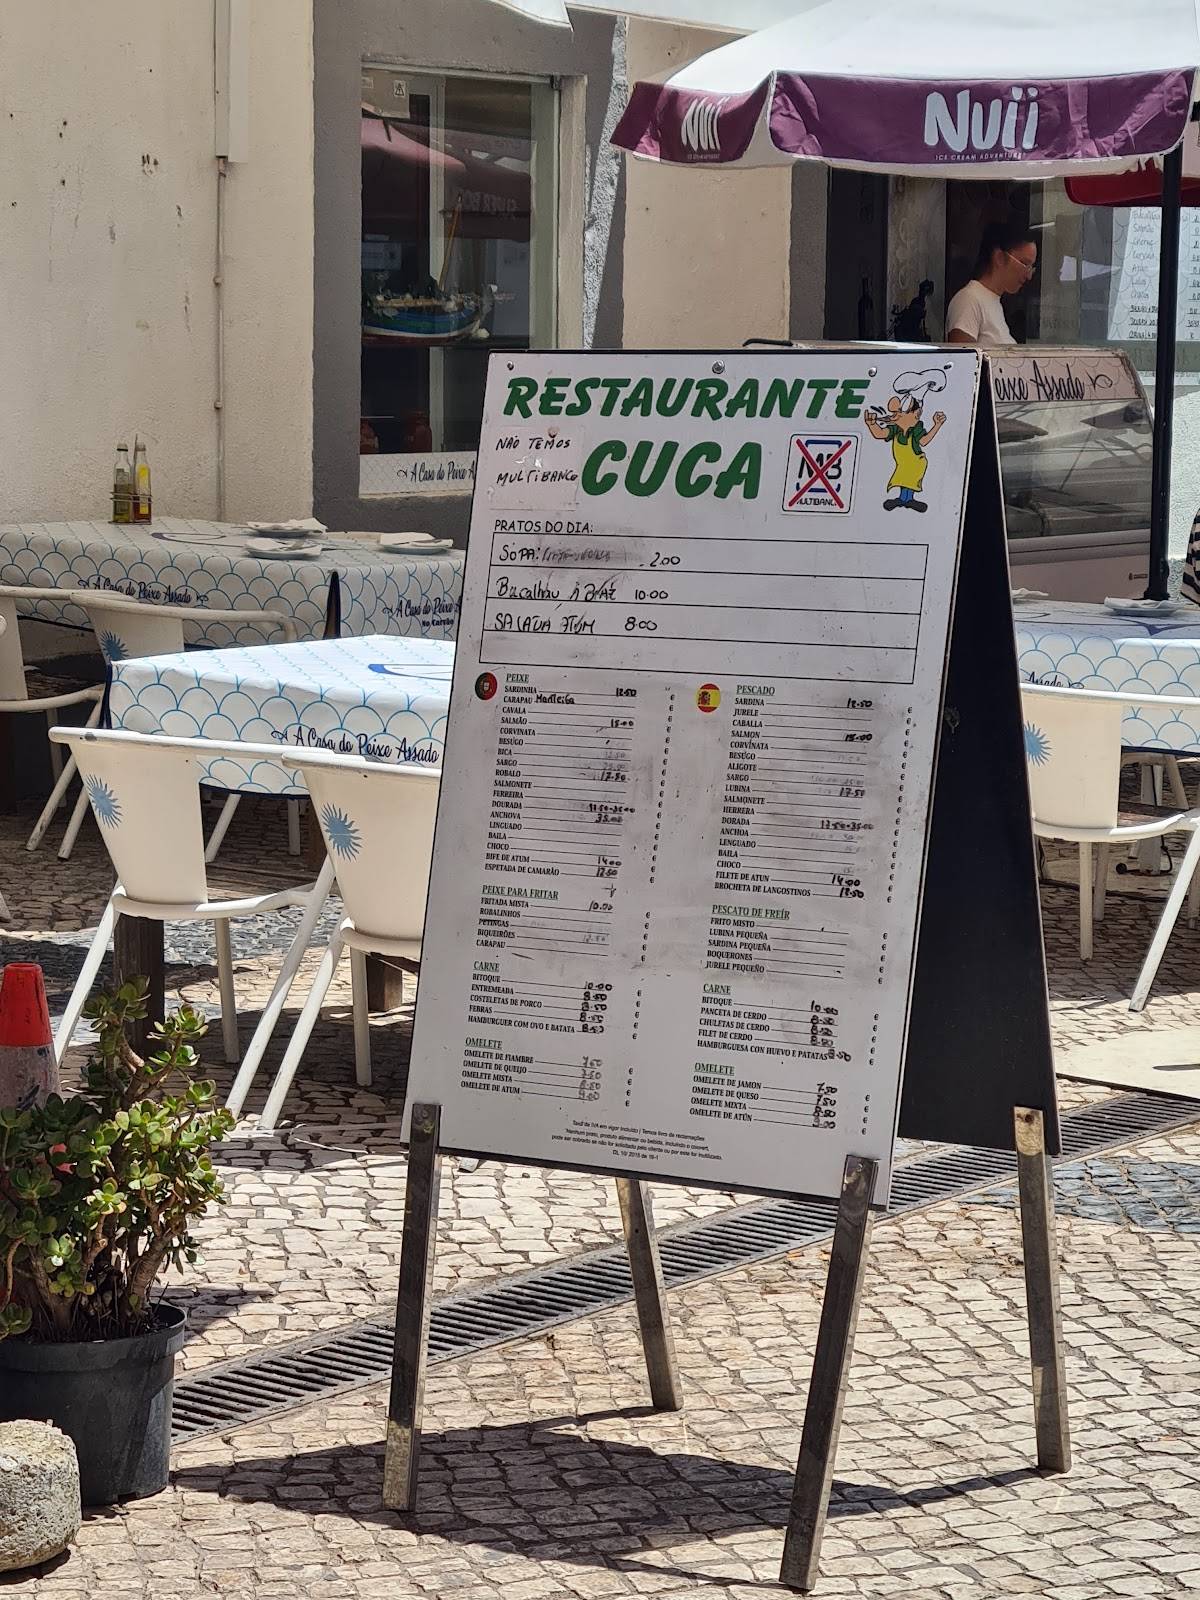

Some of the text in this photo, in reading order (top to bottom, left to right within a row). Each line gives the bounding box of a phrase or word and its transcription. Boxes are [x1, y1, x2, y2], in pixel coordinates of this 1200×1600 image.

[995, 360, 1084, 400] eixe Assado
[503, 377, 869, 420] RESTAURANTE
[529, 437, 571, 449] TEMOS
[581, 440, 762, 499] CUCA
[798, 453, 842, 479] MB
[411, 463, 417, 482] A
[794, 498, 839, 506] ULTIBANC
[494, 520, 593, 533] PRATOS DO DIA:
[396, 600, 402, 618] A
[506, 674, 529, 683] PEIXE
[505, 686, 537, 694] SARDINHA
[737, 685, 775, 695] PESCADO
[503, 696, 533, 704] CARAPAU
[735, 698, 765, 706] SARDINA
[733, 709, 759, 717] JURELE
[501, 716, 527, 725] SALMÃO
[733, 720, 763, 728] CABALLA
[500, 727, 536, 736] CORVINATA
[731, 730, 760, 739] SALMON
[293, 726, 304, 746] A
[357, 733, 392, 757] Peixe
[395, 738, 439, 762] Assado
[498, 748, 512, 756] BICA
[496, 759, 517, 767] SARGO
[728, 763, 757, 771] ALIGOTE
[495, 769, 521, 777] ROBALO
[494, 780, 532, 788] SALMONETE
[725, 785, 750, 793] LUBINA
[493, 790, 524, 798] FERREIRA
[724, 795, 765, 804] SALMONETE
[492, 801, 522, 809] DOURADA
[490, 811, 521, 820] ANCHOVA
[723, 806, 755, 815] HERRERA
[489, 821, 522, 830] LINGUADO
[722, 817, 750, 826] DORADA
[488, 832, 507, 840] BAILA
[720, 828, 749, 837] ANCHOA
[487, 842, 509, 850] CHOCO
[719, 839, 756, 848] LENGUADO
[511, 854, 530, 863] ATUM
[718, 850, 738, 858] BAILA
[485, 863, 559, 876] ESPETADA DE CAMARÃO
[717, 861, 741, 869] CHOCO
[716, 871, 739, 880] FILETE
[751, 874, 770, 882] ATUN
[482, 885, 559, 899] PEIXE PARA FRITAR
[715, 882, 751, 892] BROCHETA
[763, 886, 811, 897] LANGOSTINOS
[481, 898, 529, 908] FRITADA MISTA
[480, 908, 521, 918] ROBALINHOS
[712, 904, 790, 919] PESCATO DE FREÍR
[479, 919, 509, 927] PETINGAS
[710, 918, 755, 928] FRITO MISTO
[709, 929, 768, 940] LUBINA PEQUEÑA
[476, 940, 506, 948] CARAPAU
[708, 940, 771, 951] SARDINA PEQUEÑA
[707, 950, 753, 961] BOQUERONES
[474, 961, 500, 971] CARNE
[705, 961, 765, 973] JURELE PEQUEÑO
[473, 974, 501, 983] BITOQUE
[471, 984, 514, 995] ENTREMEADA
[703, 984, 731, 994] CARNE
[470, 995, 542, 1008] COSTELETAS DE PORCO
[702, 997, 732, 1006] BITOQUE
[469, 1005, 492, 1014] FEBRAS
[701, 1008, 767, 1020] PANCETA DE CERDO
[468, 1016, 513, 1027] HAMBURGUER
[514, 1020, 529, 1028] COM
[530, 1021, 543, 1029] OVO
[551, 1023, 575, 1032] BATATA
[700, 1018, 734, 1029] CHULETAS
[746, 1022, 770, 1032] CERDO
[699, 1029, 753, 1041] FILET DE CERDO
[465, 1037, 503, 1048] OMELETE
[697, 1040, 749, 1052] HAMBURGUESA
[750, 1045, 765, 1053] CON
[766, 1047, 791, 1056] HUEVO
[798, 1050, 827, 1060] PATATAS
[464, 1050, 494, 1059] OMELETE
[505, 1053, 534, 1064] FIAMBRE
[463, 1061, 527, 1073] OMELETE DE QUEIJO
[694, 1063, 735, 1074] OMELETE
[462, 1071, 513, 1082] OMELETE MISTA
[461, 1081, 490, 1091] OMELETE
[501, 1085, 520, 1094] ATUM
